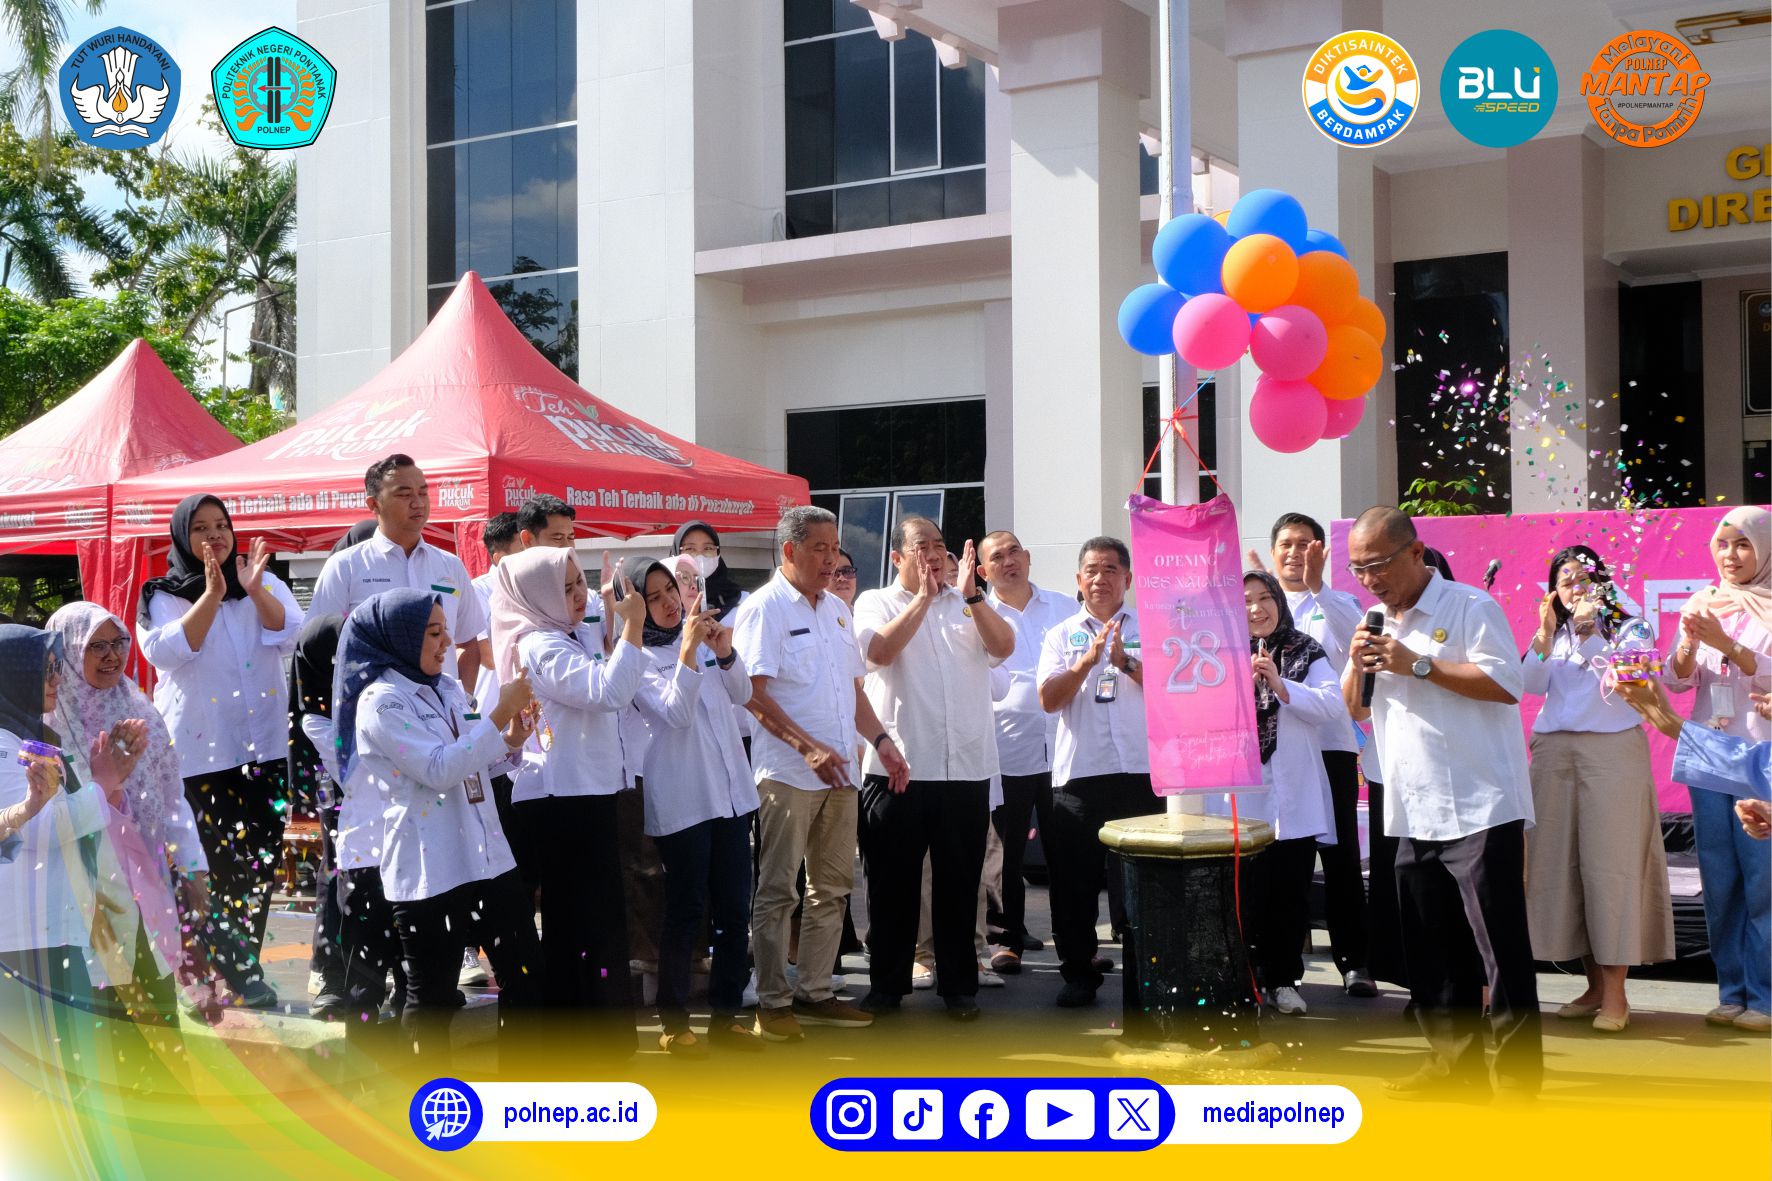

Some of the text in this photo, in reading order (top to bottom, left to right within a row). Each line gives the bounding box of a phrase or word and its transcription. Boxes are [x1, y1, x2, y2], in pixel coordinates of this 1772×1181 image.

[238, 494, 286, 514] Terbaik
[289, 492, 313, 511] ada
[316, 490, 329, 510] di
[566, 486, 596, 506] Rasa
[598, 488, 619, 508] Teh
[621, 489, 663, 509] Terbaik
[665, 493, 686, 511] ada
[688, 494, 699, 511] di
[700, 495, 755, 515] Pucuknya!
[1154, 554, 1217, 568] OPENING
[1138, 574, 1238, 589] DIES NATALIS
[1162, 630, 1226, 694] 28
